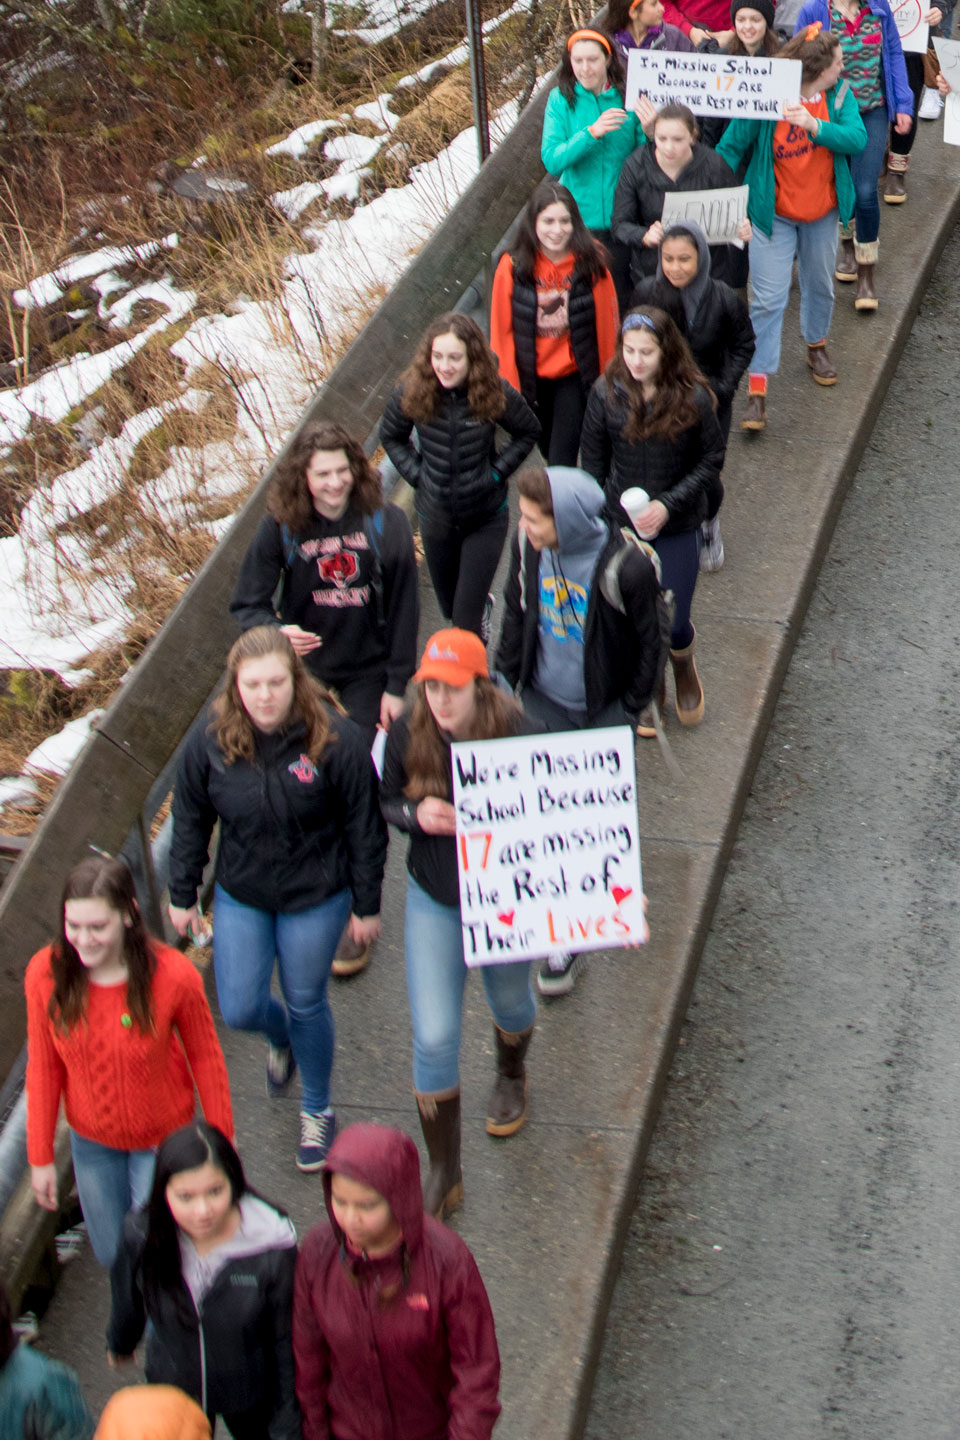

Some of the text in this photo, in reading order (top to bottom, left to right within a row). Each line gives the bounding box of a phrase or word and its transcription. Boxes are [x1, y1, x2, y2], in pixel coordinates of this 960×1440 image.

[716, 76, 735, 91] 17
[723, 59, 773, 75] School
[456, 747, 620, 789] We're Missing
[459, 783, 632, 827] School Because
[460, 823, 632, 871] 17 are missing
[464, 855, 620, 909] the Rest of
[463, 907, 631, 956] Their Lives
